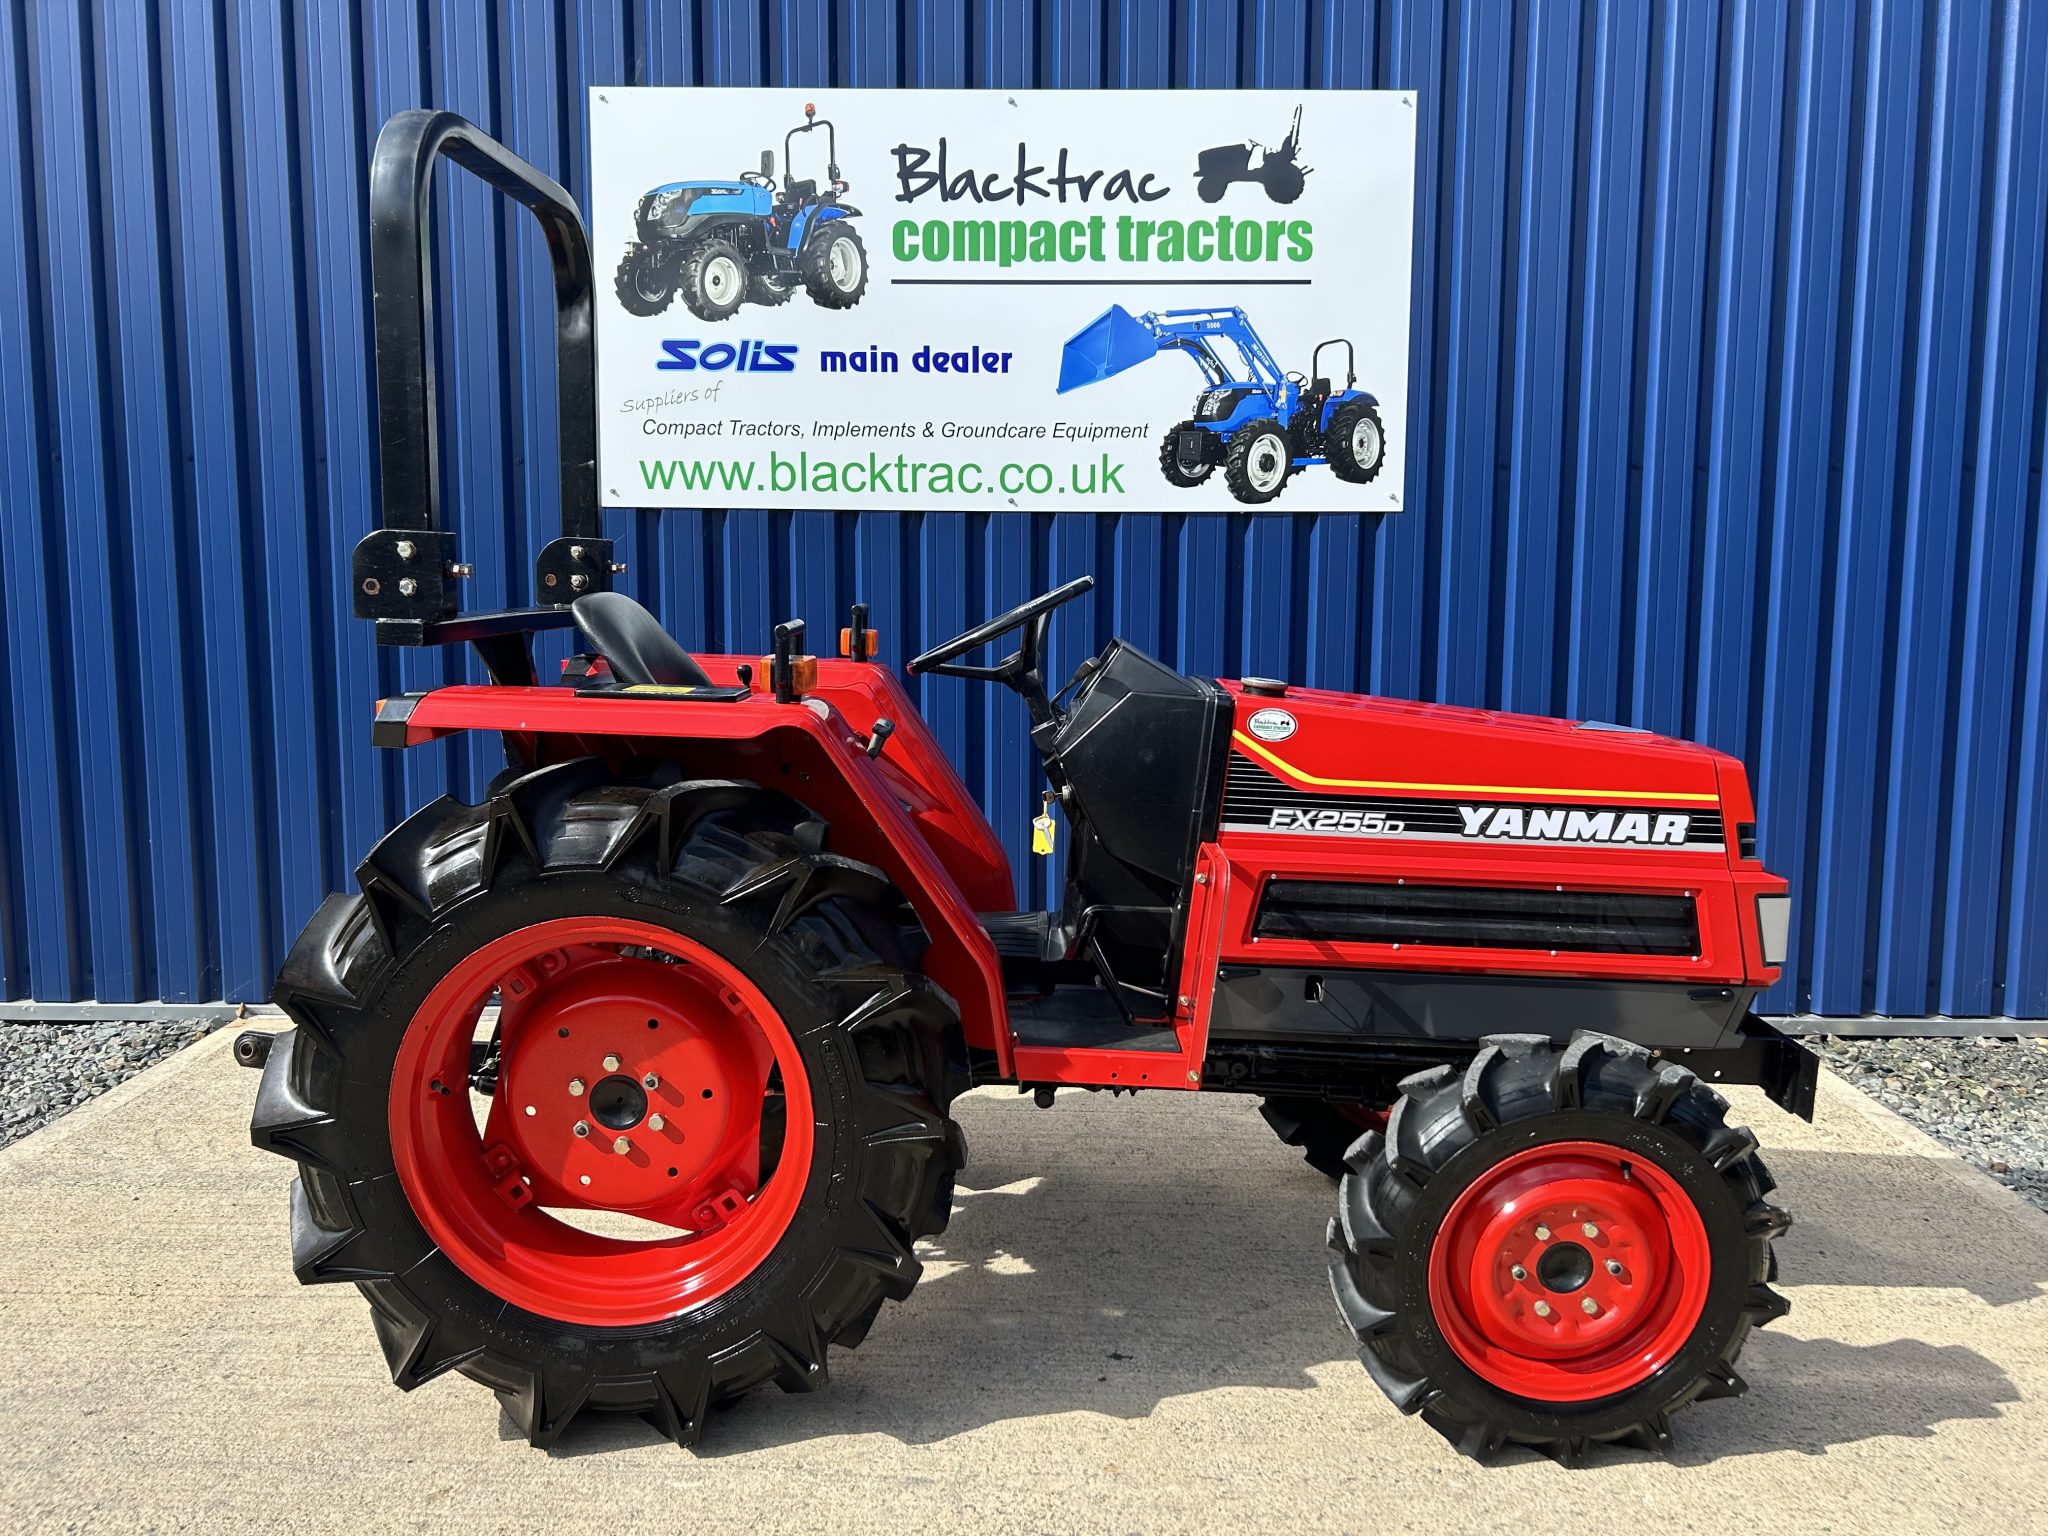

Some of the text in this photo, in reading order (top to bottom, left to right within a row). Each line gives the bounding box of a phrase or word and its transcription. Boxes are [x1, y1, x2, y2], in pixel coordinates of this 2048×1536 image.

[890, 137, 1171, 206] Blacktrac
[893, 215, 1314, 267] compact tractors
[821, 345, 1013, 373] main dealer
[620, 380, 724, 415] Suppliers of
[642, 418, 1150, 443] Compact Tractors, Implements & Groundcare Equipment
[639, 450, 1126, 494] www.blacktrac.co.uk
[1268, 808, 1405, 835] FX255D
[1456, 806, 1692, 844] YANMAR
